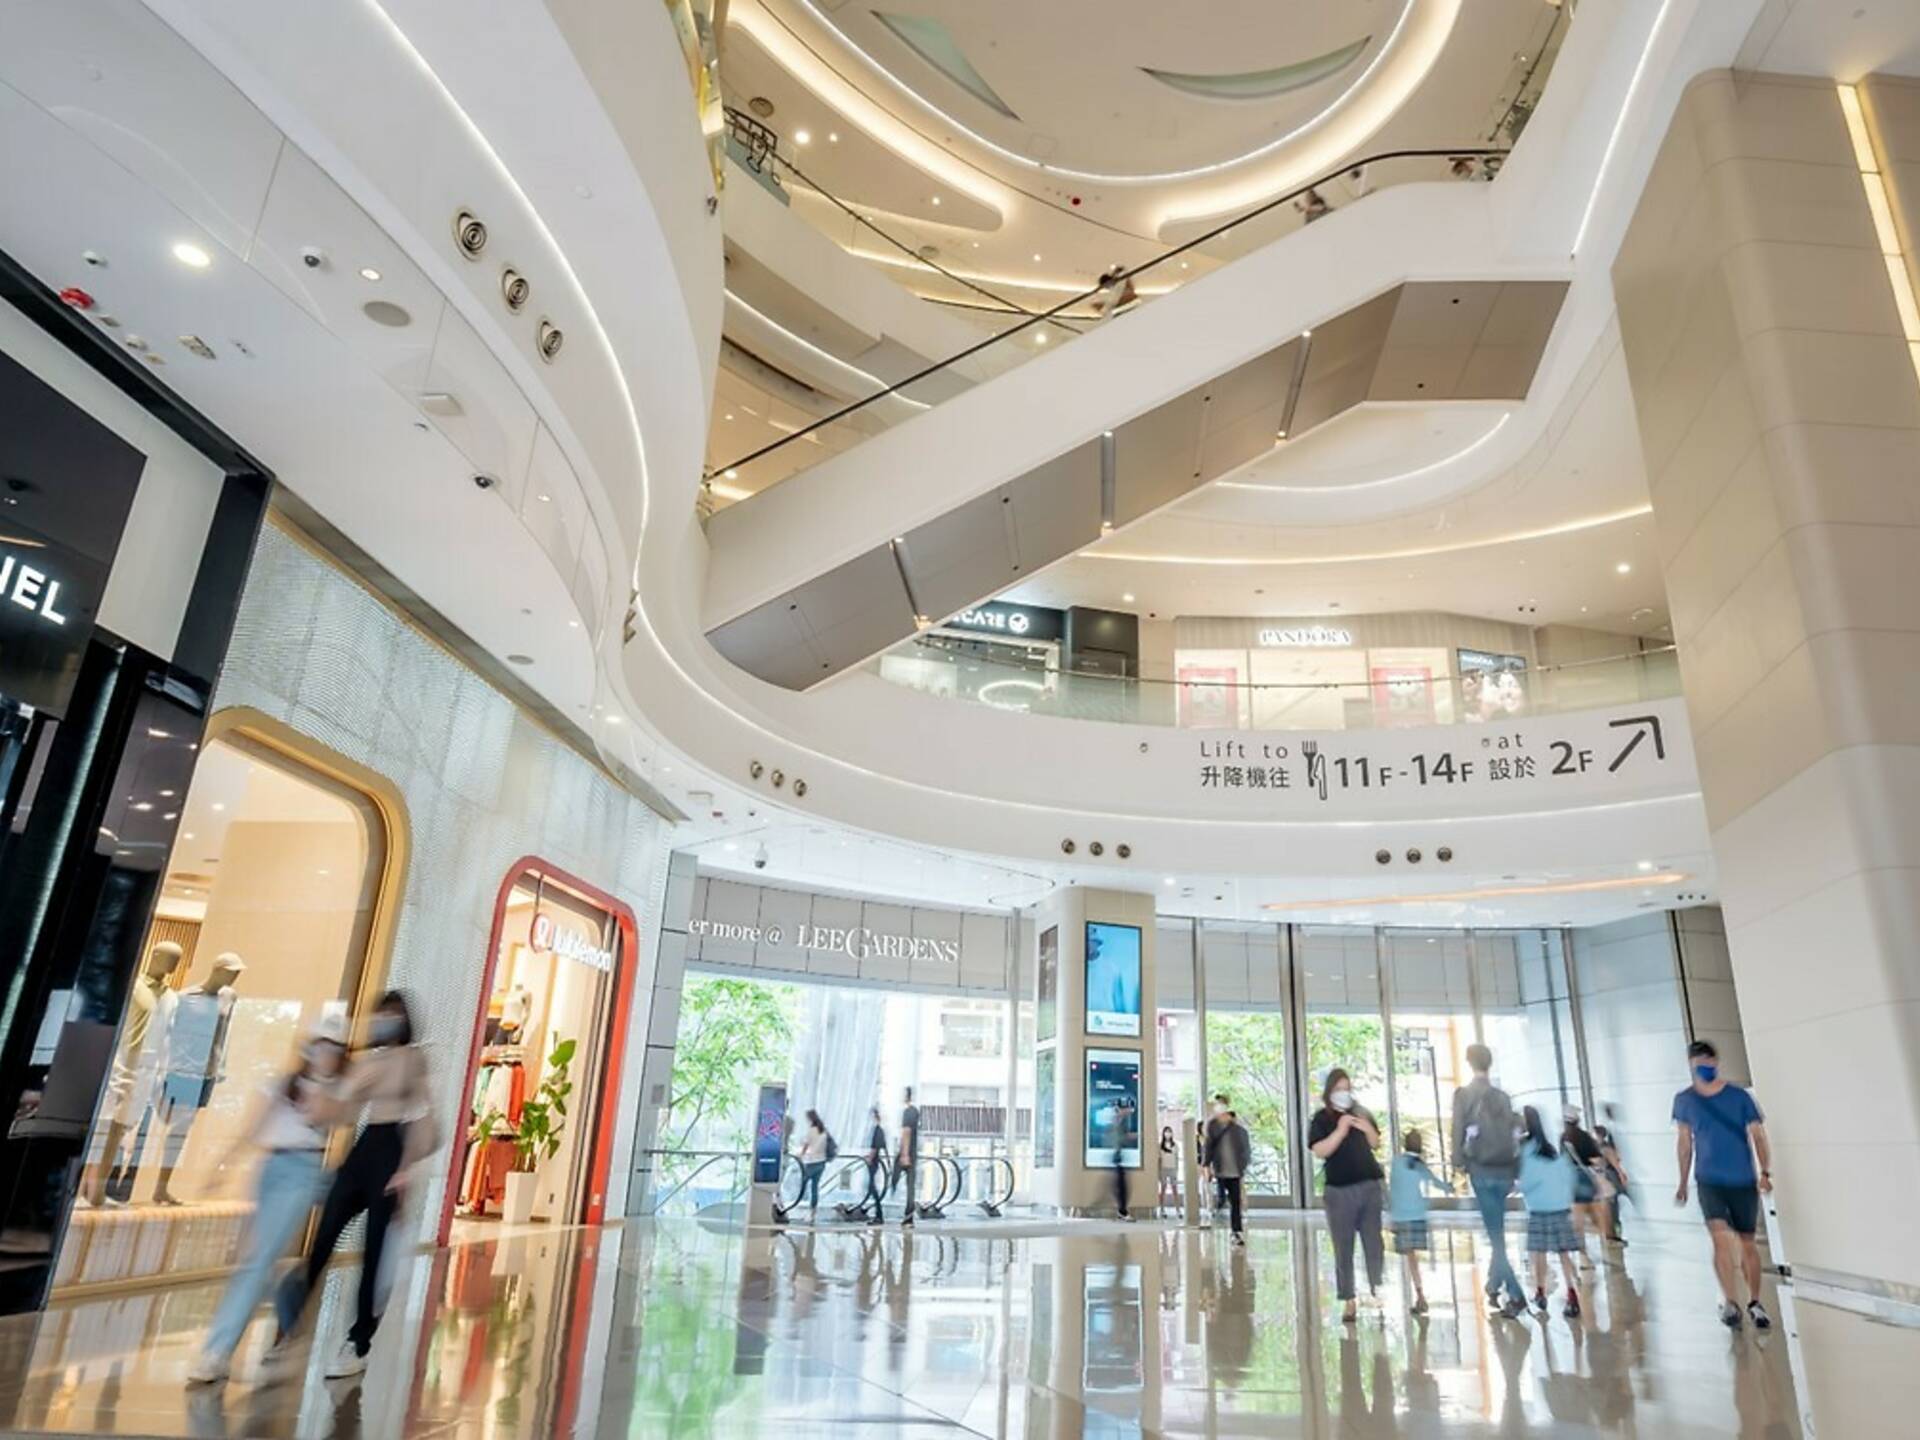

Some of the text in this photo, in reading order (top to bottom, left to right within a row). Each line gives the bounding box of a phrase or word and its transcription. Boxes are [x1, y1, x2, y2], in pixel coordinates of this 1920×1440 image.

[1260, 626, 1351, 645] PANDORA
[1200, 740, 1288, 759] Lift to
[1550, 740, 1593, 775] 2F
[1200, 765, 1291, 788] 升降機往
[1488, 755, 1536, 781] 設於
[711, 922, 761, 943] more
